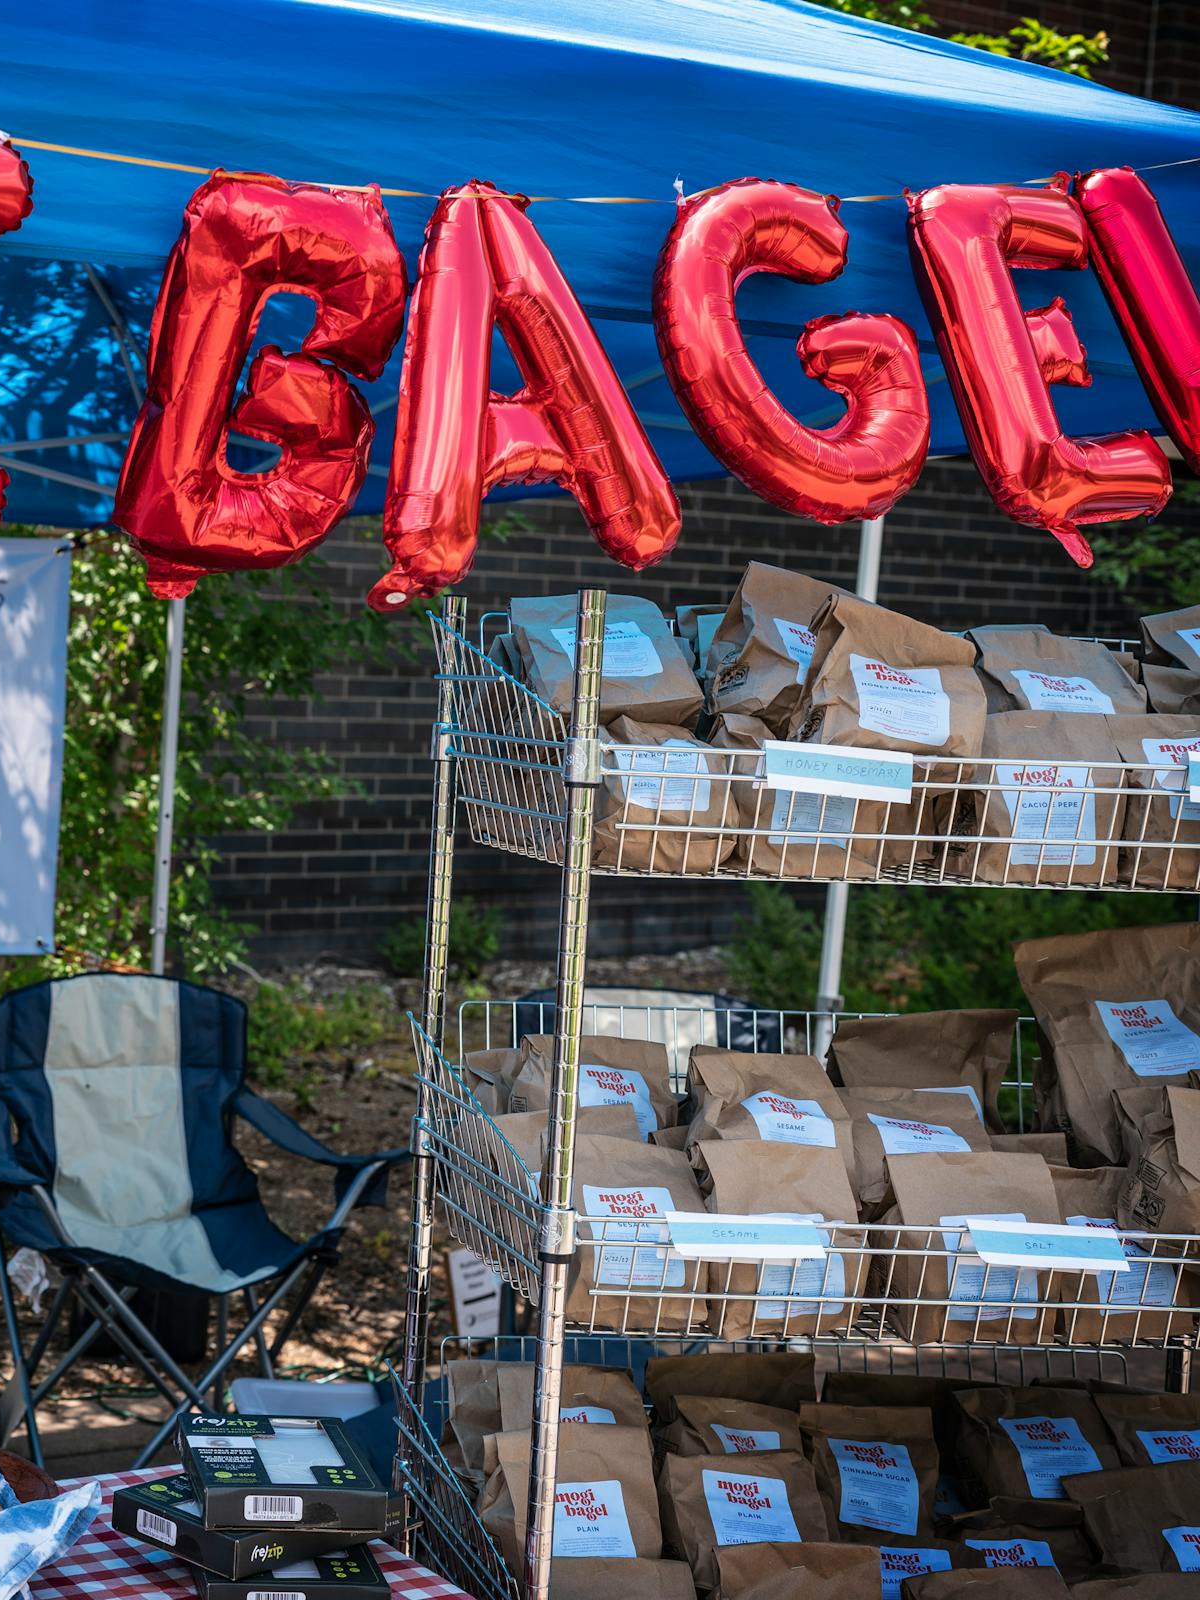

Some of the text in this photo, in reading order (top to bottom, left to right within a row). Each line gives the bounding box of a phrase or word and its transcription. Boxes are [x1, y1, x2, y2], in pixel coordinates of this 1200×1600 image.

[861, 681, 937, 696] HONEY ROSEMARY
[785, 758, 902, 781] HONEY ROSEMARY
[1110, 1005, 1148, 1019] mogi
[1120, 1016, 1164, 1029] bagel
[586, 1069, 624, 1082] mogi
[596, 1079, 637, 1096] bagel
[776, 1122, 806, 1131] SESAME
[599, 1190, 645, 1205] mogi
[608, 1203, 657, 1218] bagel
[712, 1229, 760, 1240] SESAME
[1024, 1241, 1055, 1250] SALT
[843, 1444, 885, 1458] mogi
[854, 1453, 898, 1469] bagel
[842, 1466, 911, 1483] CINNAMON SUGAR
[717, 1480, 760, 1498] mogi
[555, 1488, 596, 1506] mogi
[726, 1492, 772, 1511] bagel
[564, 1503, 609, 1521] bagel
[738, 1511, 762, 1519] PLAIN
[251, 1543, 284, 1562] (re)zip
[981, 1543, 1025, 1562] mogi
